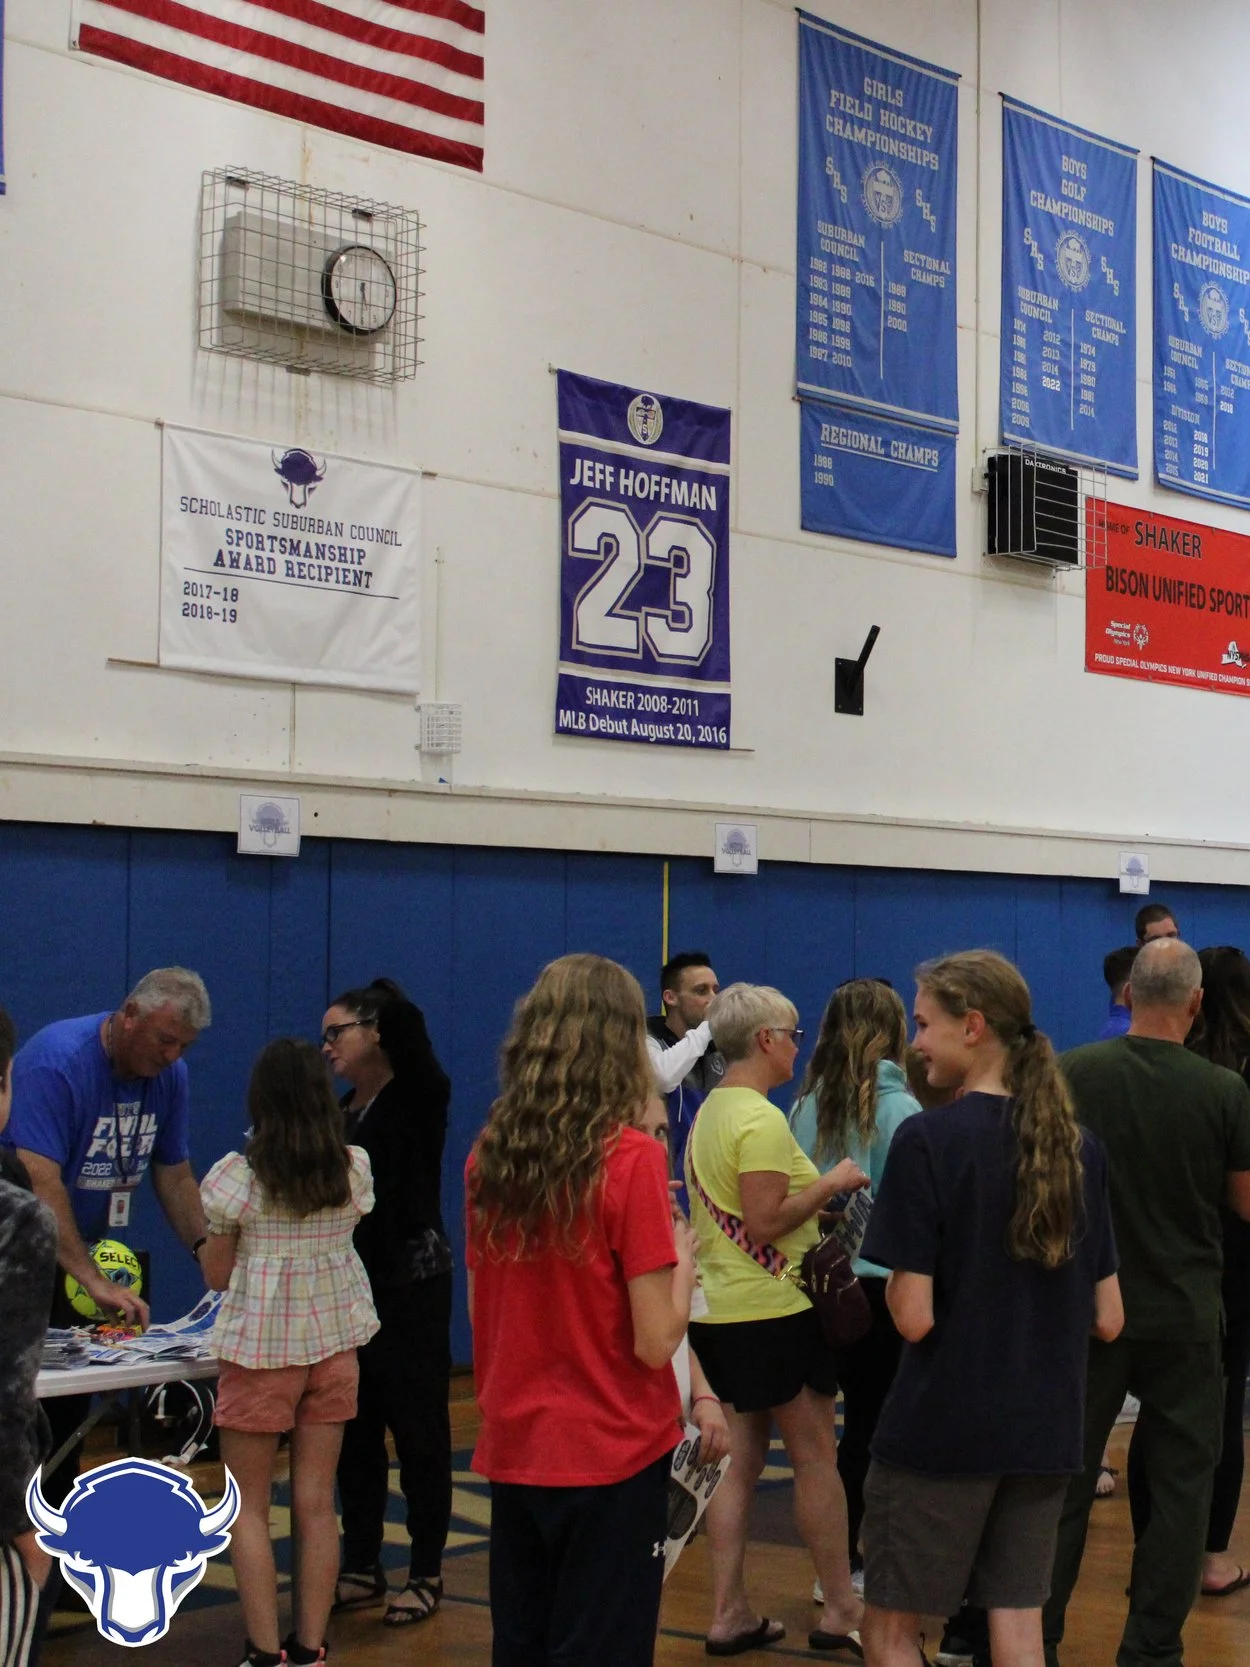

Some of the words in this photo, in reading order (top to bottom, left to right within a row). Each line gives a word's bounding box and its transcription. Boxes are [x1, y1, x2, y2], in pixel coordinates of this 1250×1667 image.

[864, 77, 903, 107] GIRLS
[830, 90, 872, 121] FIELD
[880, 109, 933, 143] HOCKEY
[826, 115, 939, 171] CHAMPIONSHIPS
[825, 156, 847, 203] SHS
[1062, 155, 1087, 179] BOYS
[1062, 179, 1086, 202] GOLF
[916, 189, 936, 233] SHS
[1030, 190, 1114, 237] CHAMPIONSHIPS
[1202, 210, 1228, 234] BOYS
[817, 220, 865, 248] SUBURBAN
[1188, 227, 1240, 261] FOOTBALL
[821, 237, 859, 262] COUNCIL
[1024, 227, 1044, 271] SHS
[856, 271, 875, 287] 2016
[911, 267, 945, 288] CHAMPS
[1101, 256, 1119, 297] SHS
[832, 300, 852, 316] 1990
[1020, 304, 1052, 324] COUNCIL
[1085, 310, 1126, 334] SECTIONAL
[1043, 331, 1061, 345] 2012
[1092, 327, 1119, 346] CHAMPS
[832, 352, 852, 368] 2010
[1042, 361, 1059, 376] 2014
[1042, 376, 1060, 391] 2022
[821, 423, 884, 455] REGIONAL
[891, 439, 939, 467] CHAMPS
[1194, 444, 1209, 457] 2019
[570, 458, 614, 486] JEFF
[620, 468, 717, 511] HOFFMAN
[814, 471, 834, 487] 1990
[180, 496, 266, 525] SCHOLASTIC
[273, 511, 344, 538] SUBURBAN
[350, 524, 402, 547] COUNCIL
[225, 528, 366, 566] SPORTSMANSHIP
[1135, 521, 1202, 559] SHAKER
[213, 549, 276, 576] AWARD
[285, 559, 373, 589] RECIPIENT
[568, 496, 716, 666] 23
[183, 581, 239, 602] 2017-18
[1106, 565, 1149, 599] BISON
[1153, 576, 1205, 610] UNIFIED
[182, 602, 237, 623] 2018-19
[1095, 653, 1115, 664] PROUD
[1115, 656, 1139, 669] SPECIAL
[1140, 660, 1167, 673] OLYMPICS
[1168, 665, 1181, 675] NEW
[1181, 668, 1196, 678] YORK
[1196, 670, 1218, 681] UNIFIED
[1218, 674, 1246, 686] CHAMPION
[586, 686, 635, 710] SHAKER
[637, 692, 699, 717] 2008-2011
[559, 709, 586, 731] MLB
[590, 713, 628, 735] Debut
[630, 716, 675, 741] August
[676, 722, 695, 744] 20,
[697, 725, 727, 744] 2016
[248, 824, 292, 835] VOLLEYBALL
[81, 1162, 113, 1176] 2022
